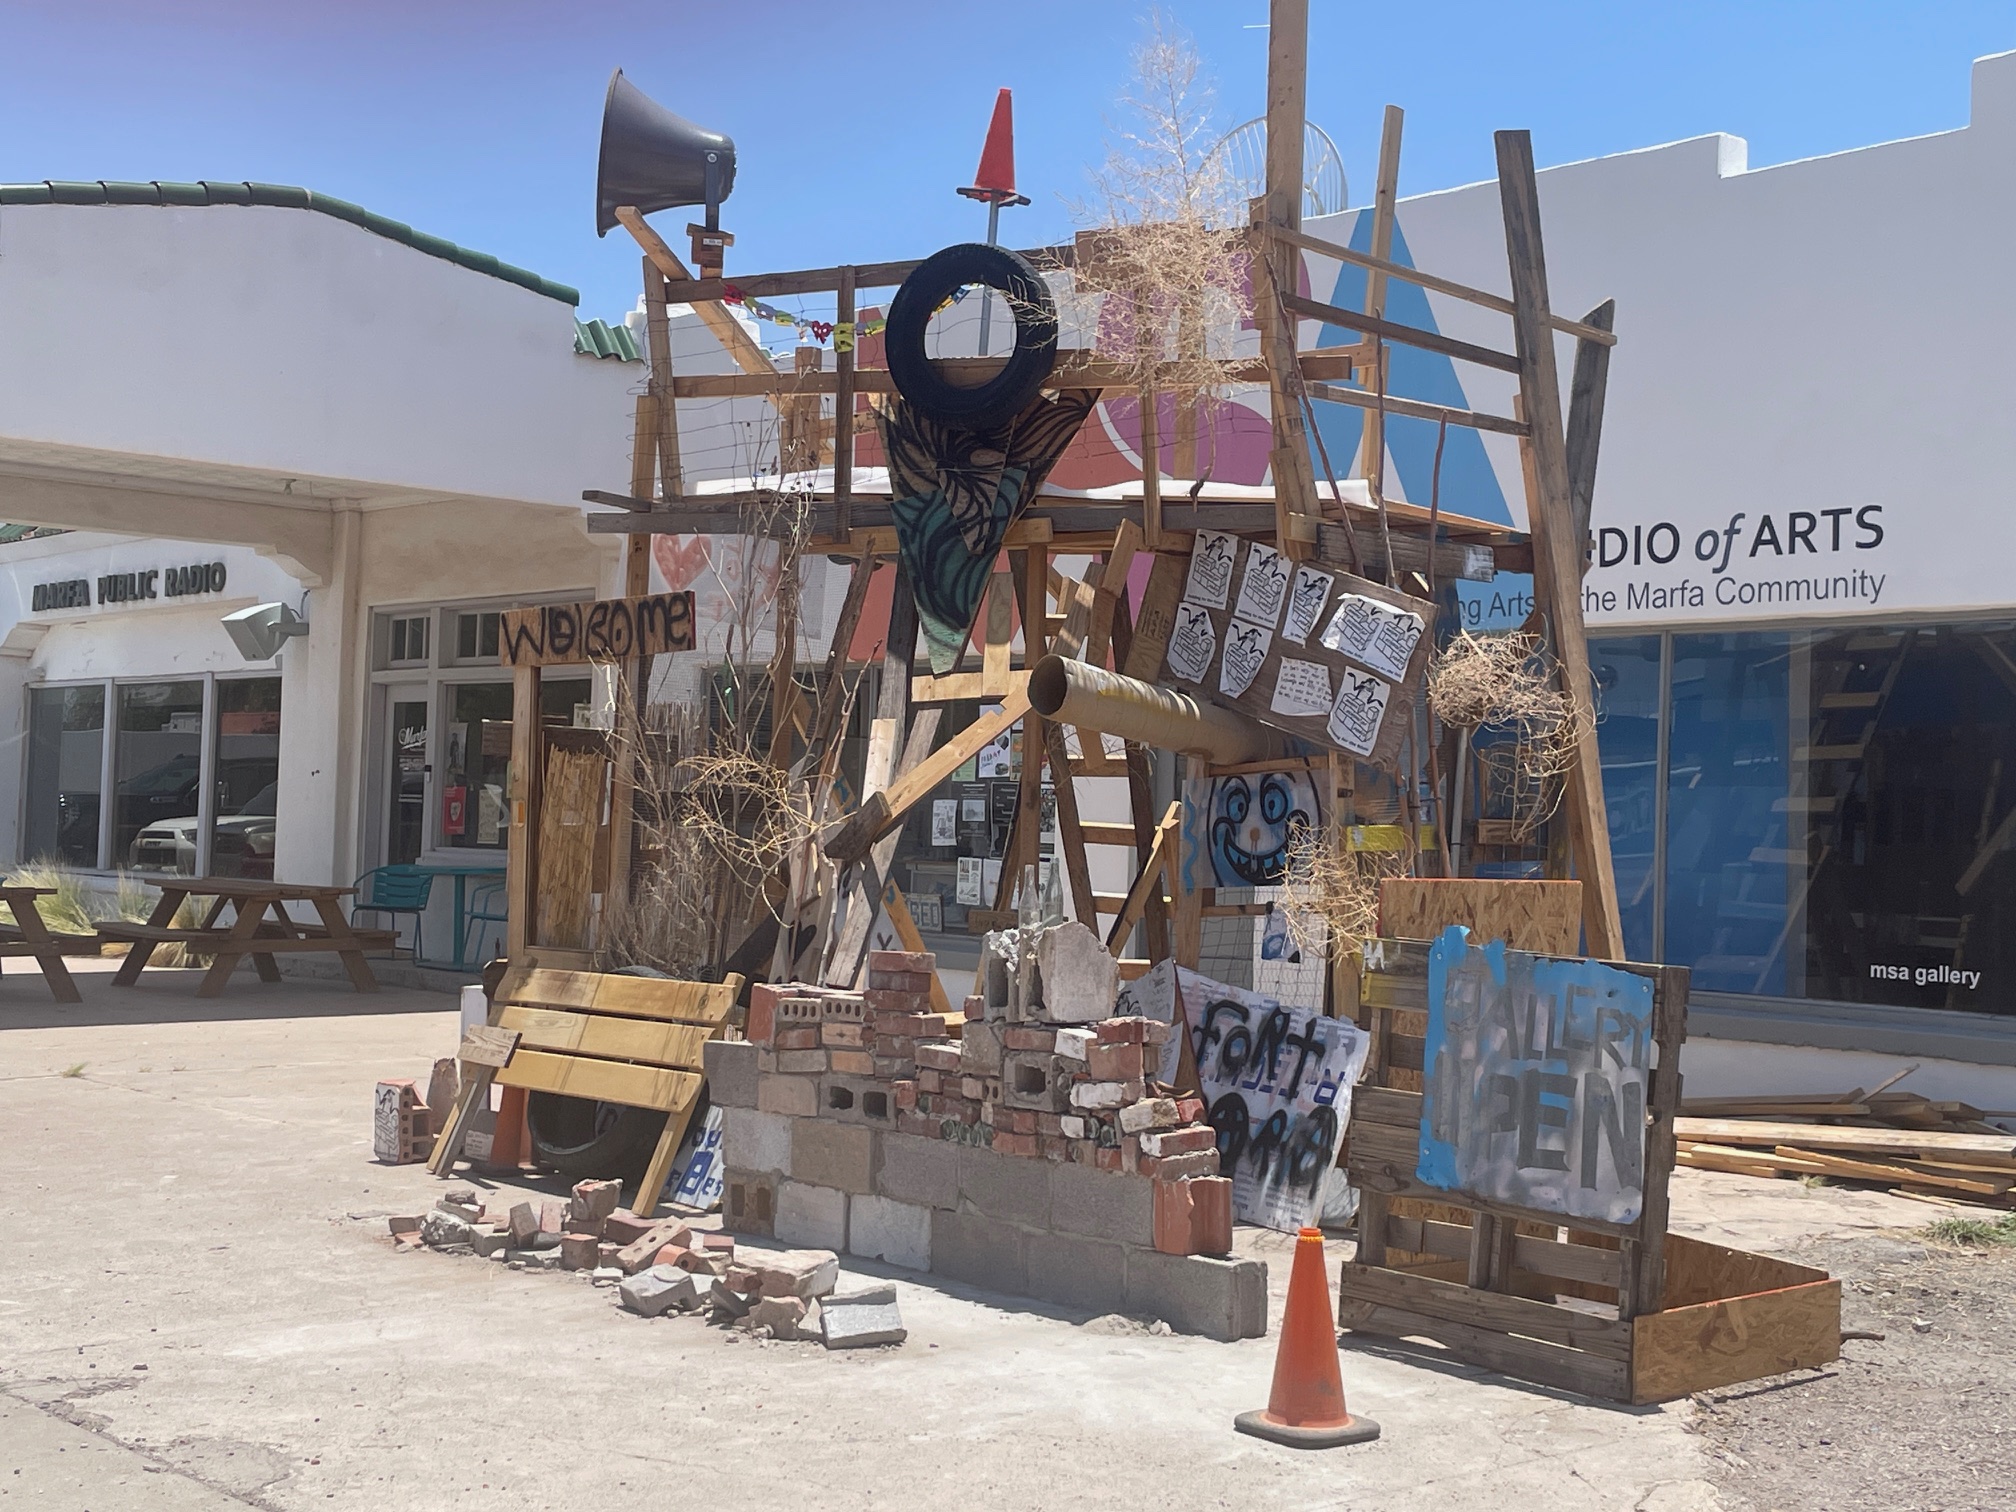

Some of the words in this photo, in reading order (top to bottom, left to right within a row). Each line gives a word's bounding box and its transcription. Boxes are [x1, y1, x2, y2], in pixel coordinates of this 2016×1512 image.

[1587, 522, 1680, 568] DIO
[1694, 513, 1746, 574] of
[1748, 505, 1885, 557] ARTS
[32, 579, 90, 611] MARFA
[97, 570, 158, 605] PUBLIC
[164, 562, 226, 598] RADIO
[1488, 591, 1536, 618] Arts
[1627, 580, 1704, 610] Marfa
[1715, 569, 1886, 604] Community
[1871, 964, 1909, 981] msa
[1915, 965, 1981, 990] gallery
